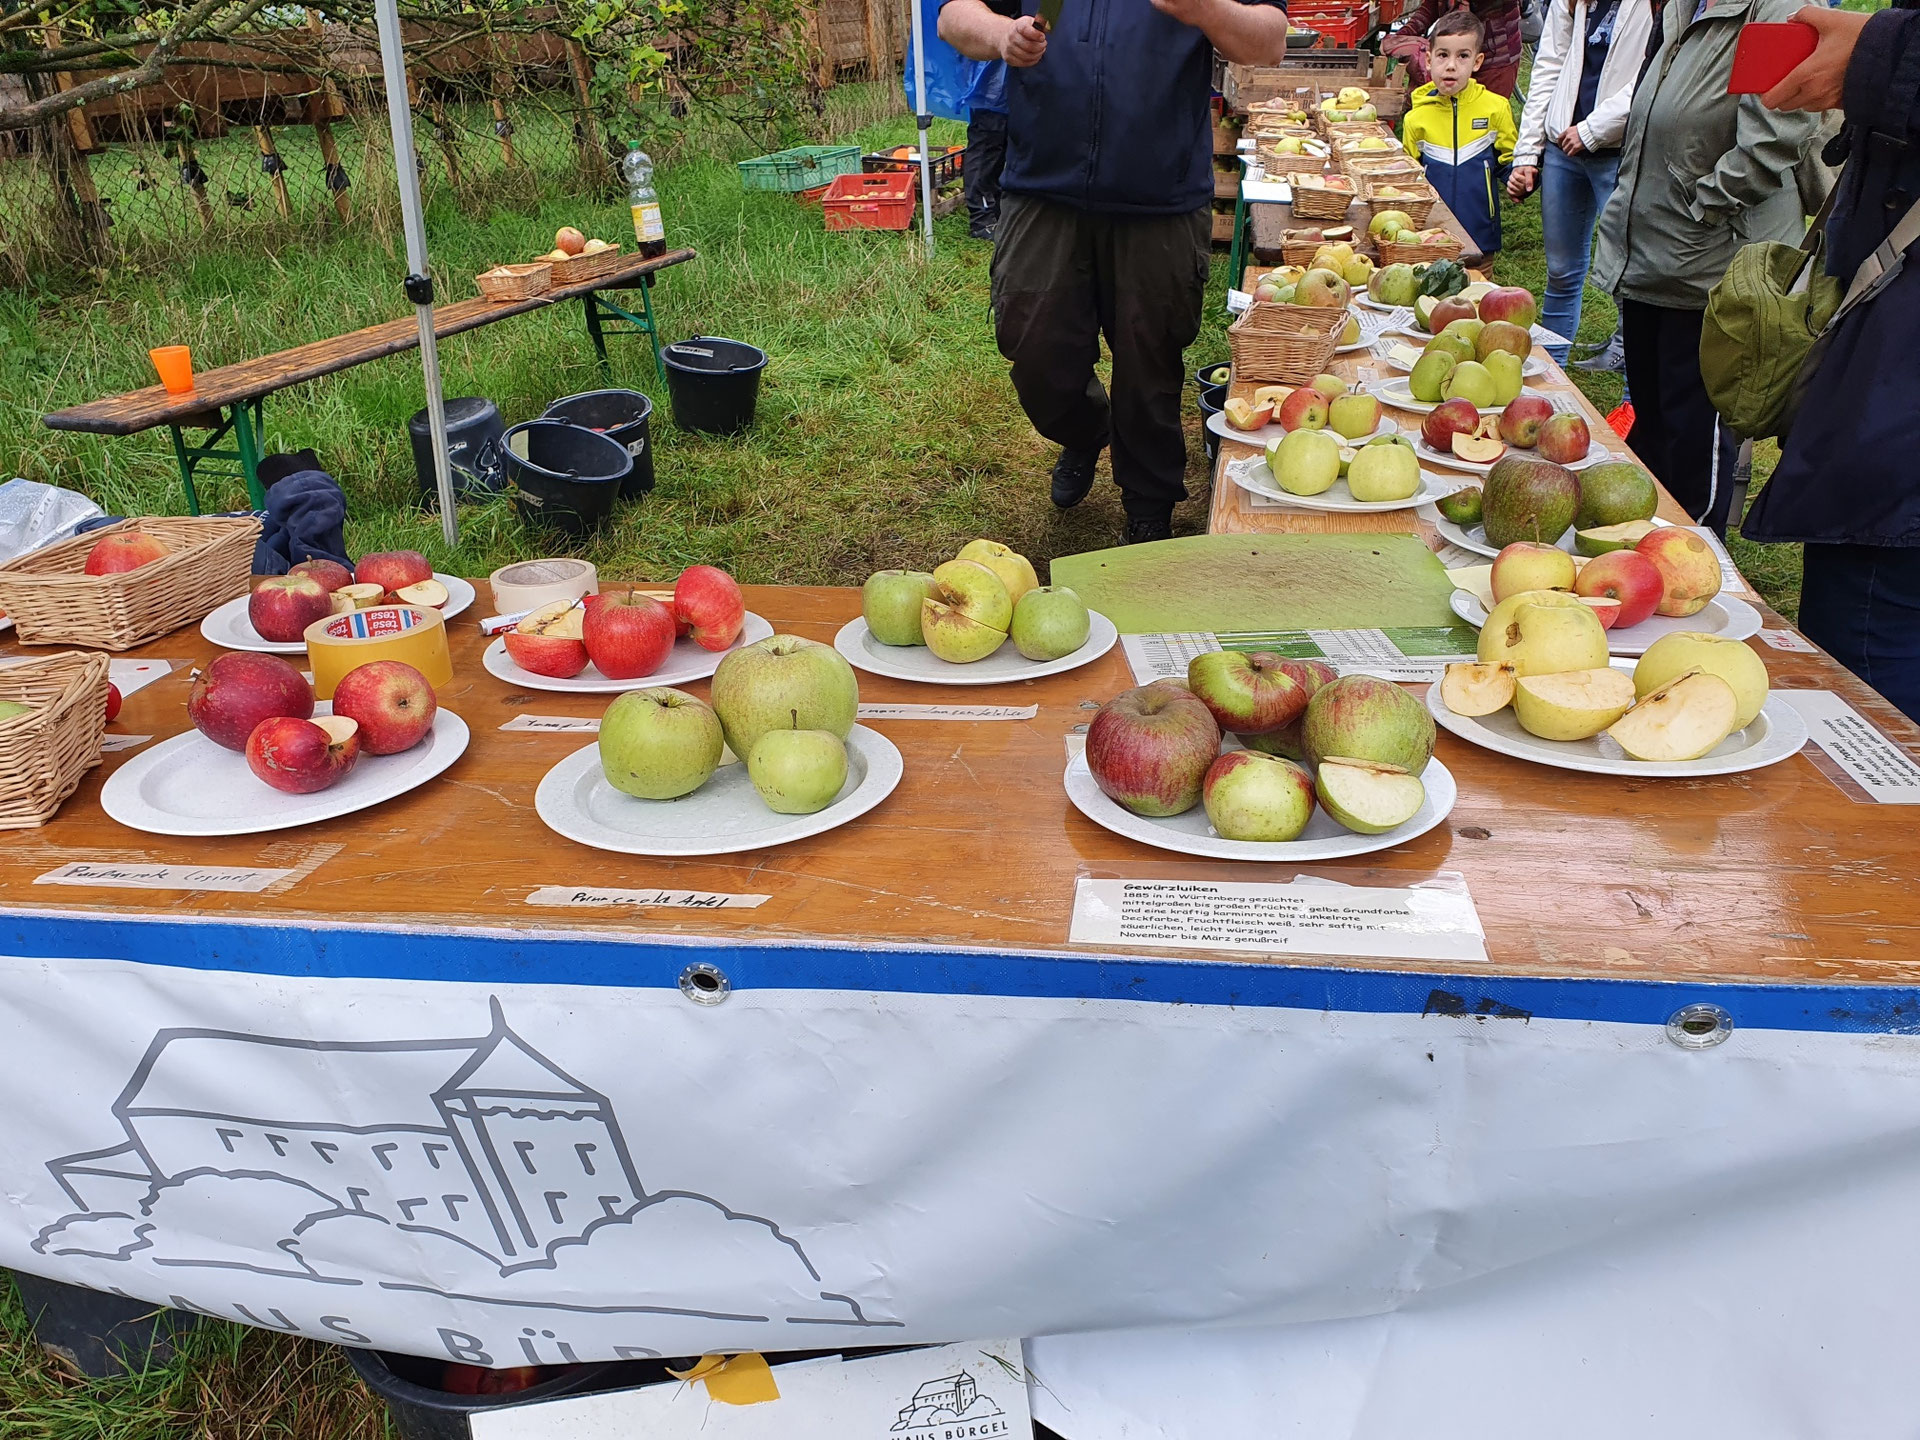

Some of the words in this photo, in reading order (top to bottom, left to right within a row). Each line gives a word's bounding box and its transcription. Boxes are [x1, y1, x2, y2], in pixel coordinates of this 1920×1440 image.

[372, 620, 399, 629] tesa
[1123, 884, 1218, 893] Gewürzluiken
[1179, 894, 1246, 903] Würtenberg
[1170, 908, 1210, 916] kräftig
[1213, 910, 1275, 918] karminrote
[1299, 913, 1361, 921] dunkelrote
[1343, 907, 1410, 915] Grundfarbe
[1120, 923, 1187, 932] säuerlichen,
[1226, 927, 1277, 935] würzigen
[1121, 915, 1183, 923] Deckfarbe,
[1187, 917, 1264, 926] Fruchtfleisch
[1328, 923, 1363, 931] saftig
[1120, 931, 1177, 939] November
[1234, 936, 1289, 944] genußreif
[945, 1420, 1009, 1440] BÜRGEL
